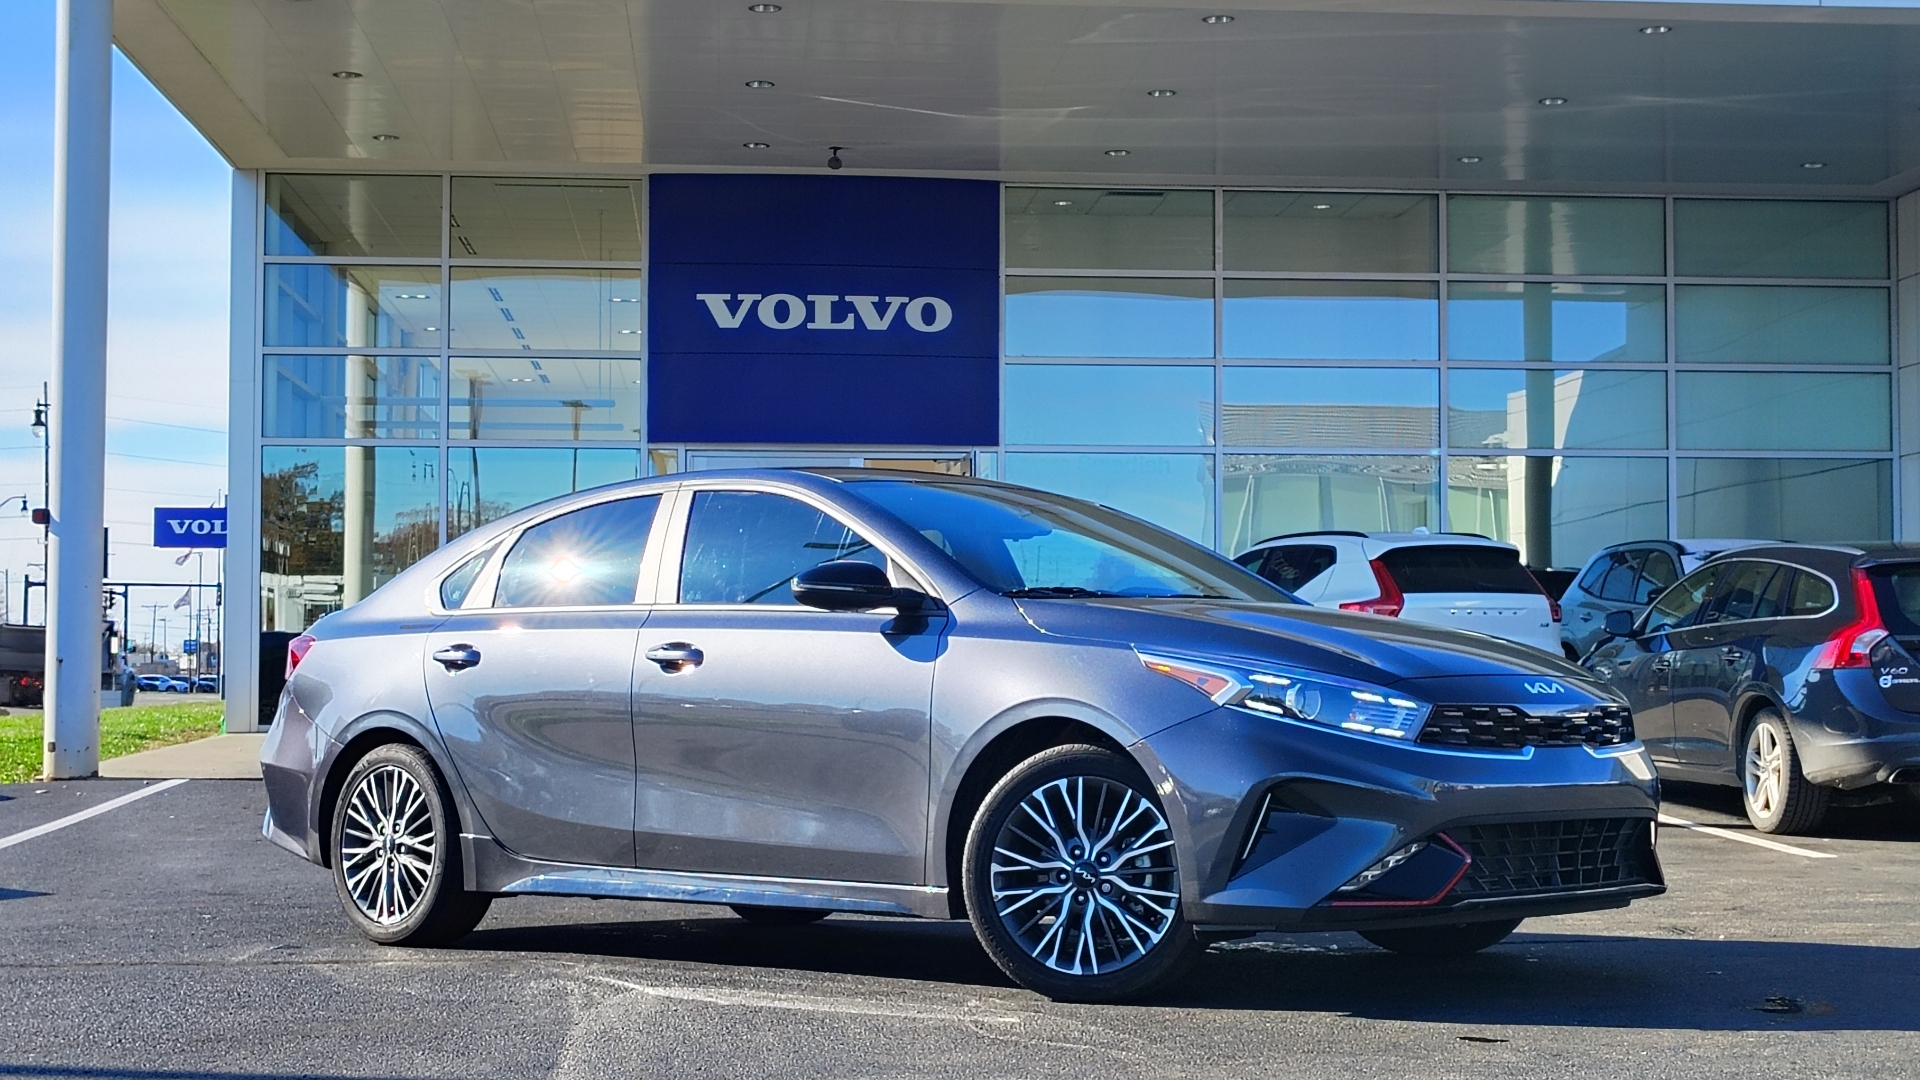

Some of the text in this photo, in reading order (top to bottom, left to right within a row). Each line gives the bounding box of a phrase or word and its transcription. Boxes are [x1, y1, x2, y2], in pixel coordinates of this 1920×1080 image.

[696, 293, 953, 333] VOLVO
[166, 519, 228, 535] VOL
[1880, 667, 1908, 675] V60
[1524, 682, 1565, 694] KIA
